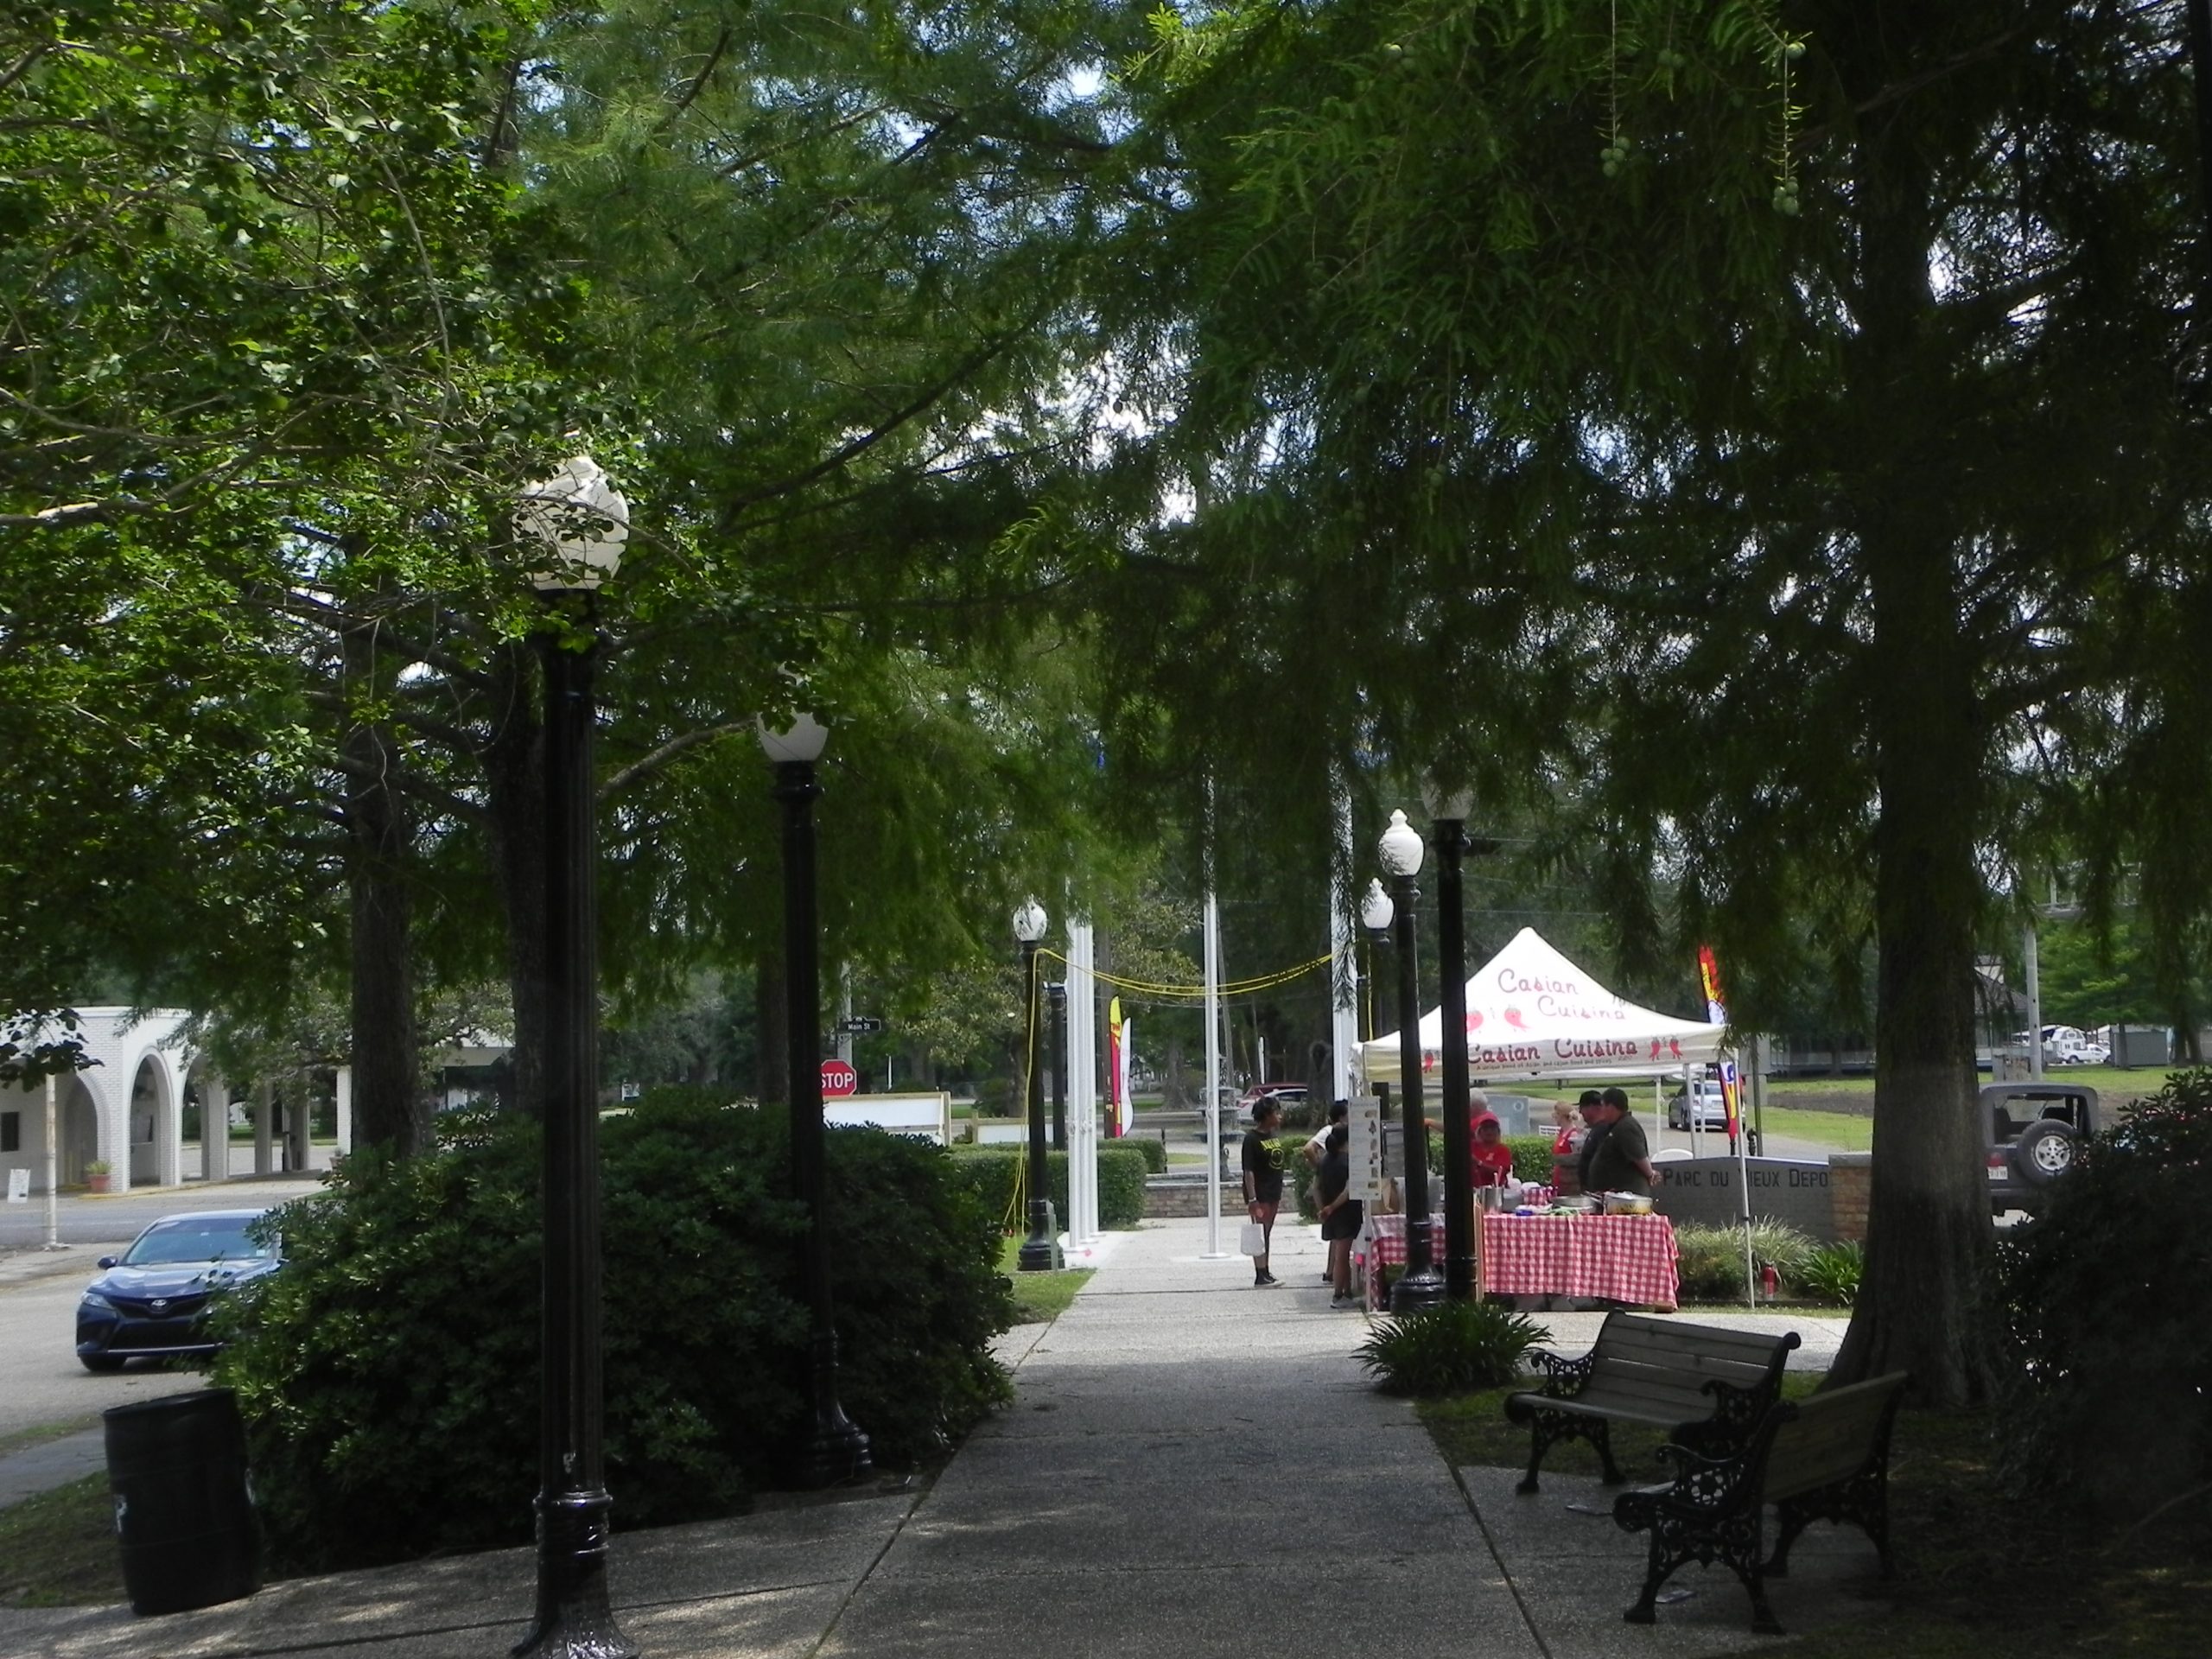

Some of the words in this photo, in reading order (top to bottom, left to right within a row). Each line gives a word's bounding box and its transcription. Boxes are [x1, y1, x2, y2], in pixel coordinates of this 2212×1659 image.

[1497, 968, 1580, 995] Casian
[1466, 1043, 1541, 1065] Casian
[821, 1072, 854, 1089] STOP
[1662, 1168, 1701, 1187] PARC
[1710, 1171, 1729, 1187] DU
[1789, 1168, 1832, 1187] DEPO
